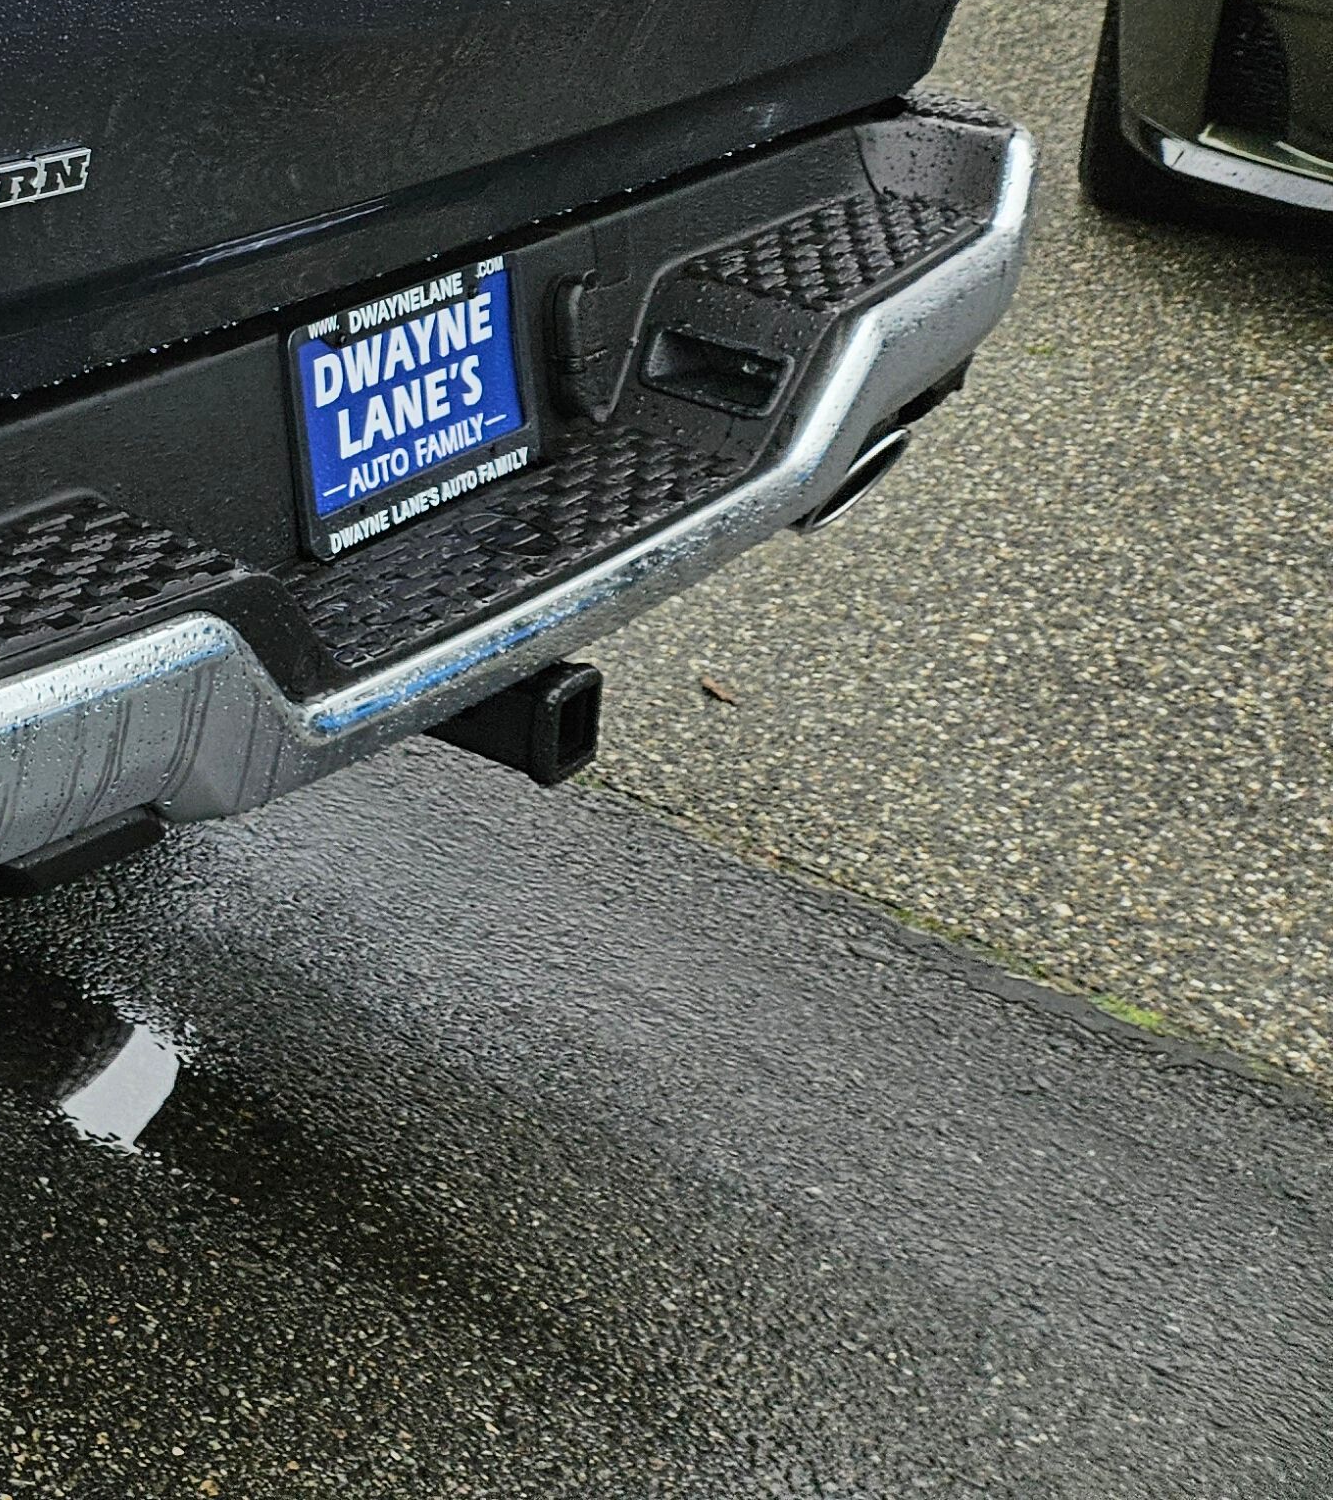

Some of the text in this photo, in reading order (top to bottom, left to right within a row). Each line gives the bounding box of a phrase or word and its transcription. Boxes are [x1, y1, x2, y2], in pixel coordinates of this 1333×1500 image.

[313, 292, 493, 408] DWAYNE
[349, 272, 464, 334] DWAYNELANE
[337, 354, 483, 460] LANE'S
[348, 412, 484, 498] AUTO FAMILY
[328, 446, 529, 554] DWAYNE LANE'S AUTO FAMILY
